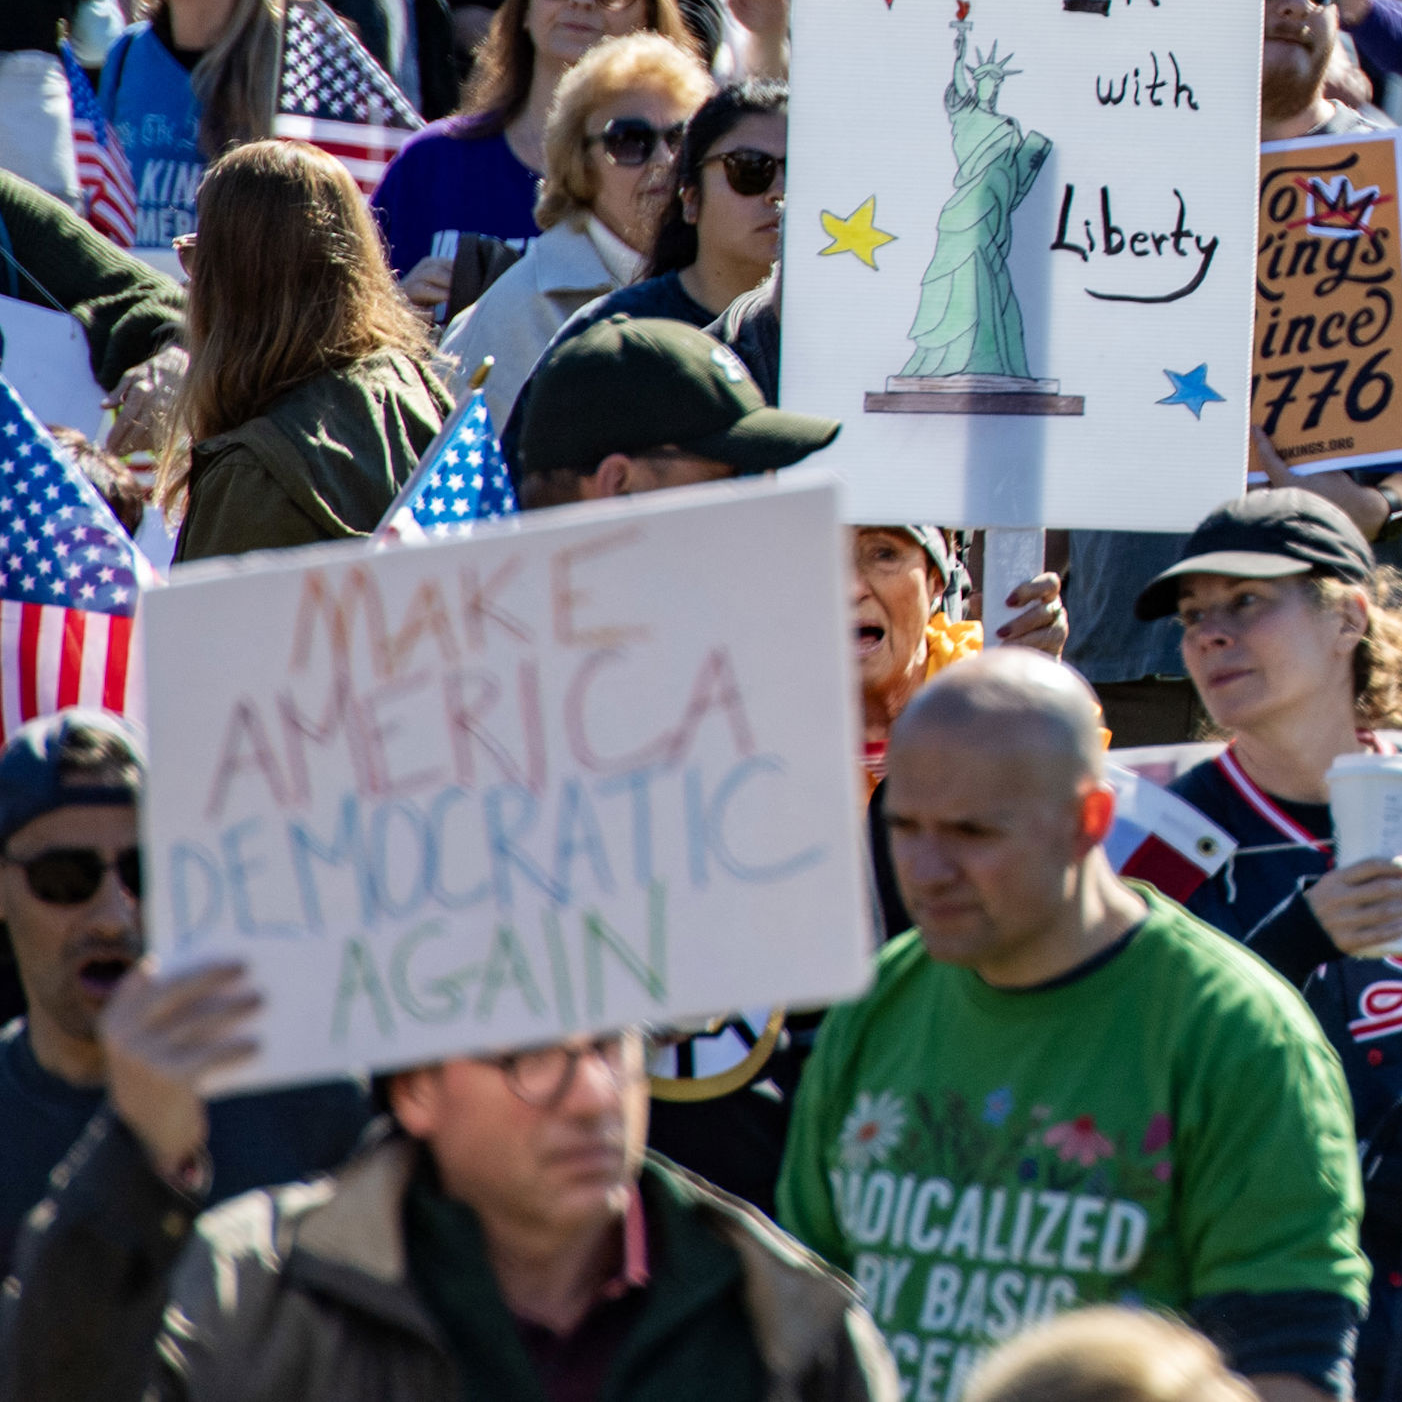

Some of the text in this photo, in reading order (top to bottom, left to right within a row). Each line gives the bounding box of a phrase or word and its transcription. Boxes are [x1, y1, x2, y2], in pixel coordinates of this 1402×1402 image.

[1096, 51, 1200, 112] with
[139, 157, 202, 205] KIN
[1050, 183, 1220, 304] Liberty
[1254, 285, 1394, 360] ince
[289, 525, 655, 678] MAKE
[206, 642, 757, 821] AMERICA
[165, 754, 830, 952] DEMOCRATIC
[328, 878, 668, 1045] AGAIN
[854, 1252, 914, 1325] BY
